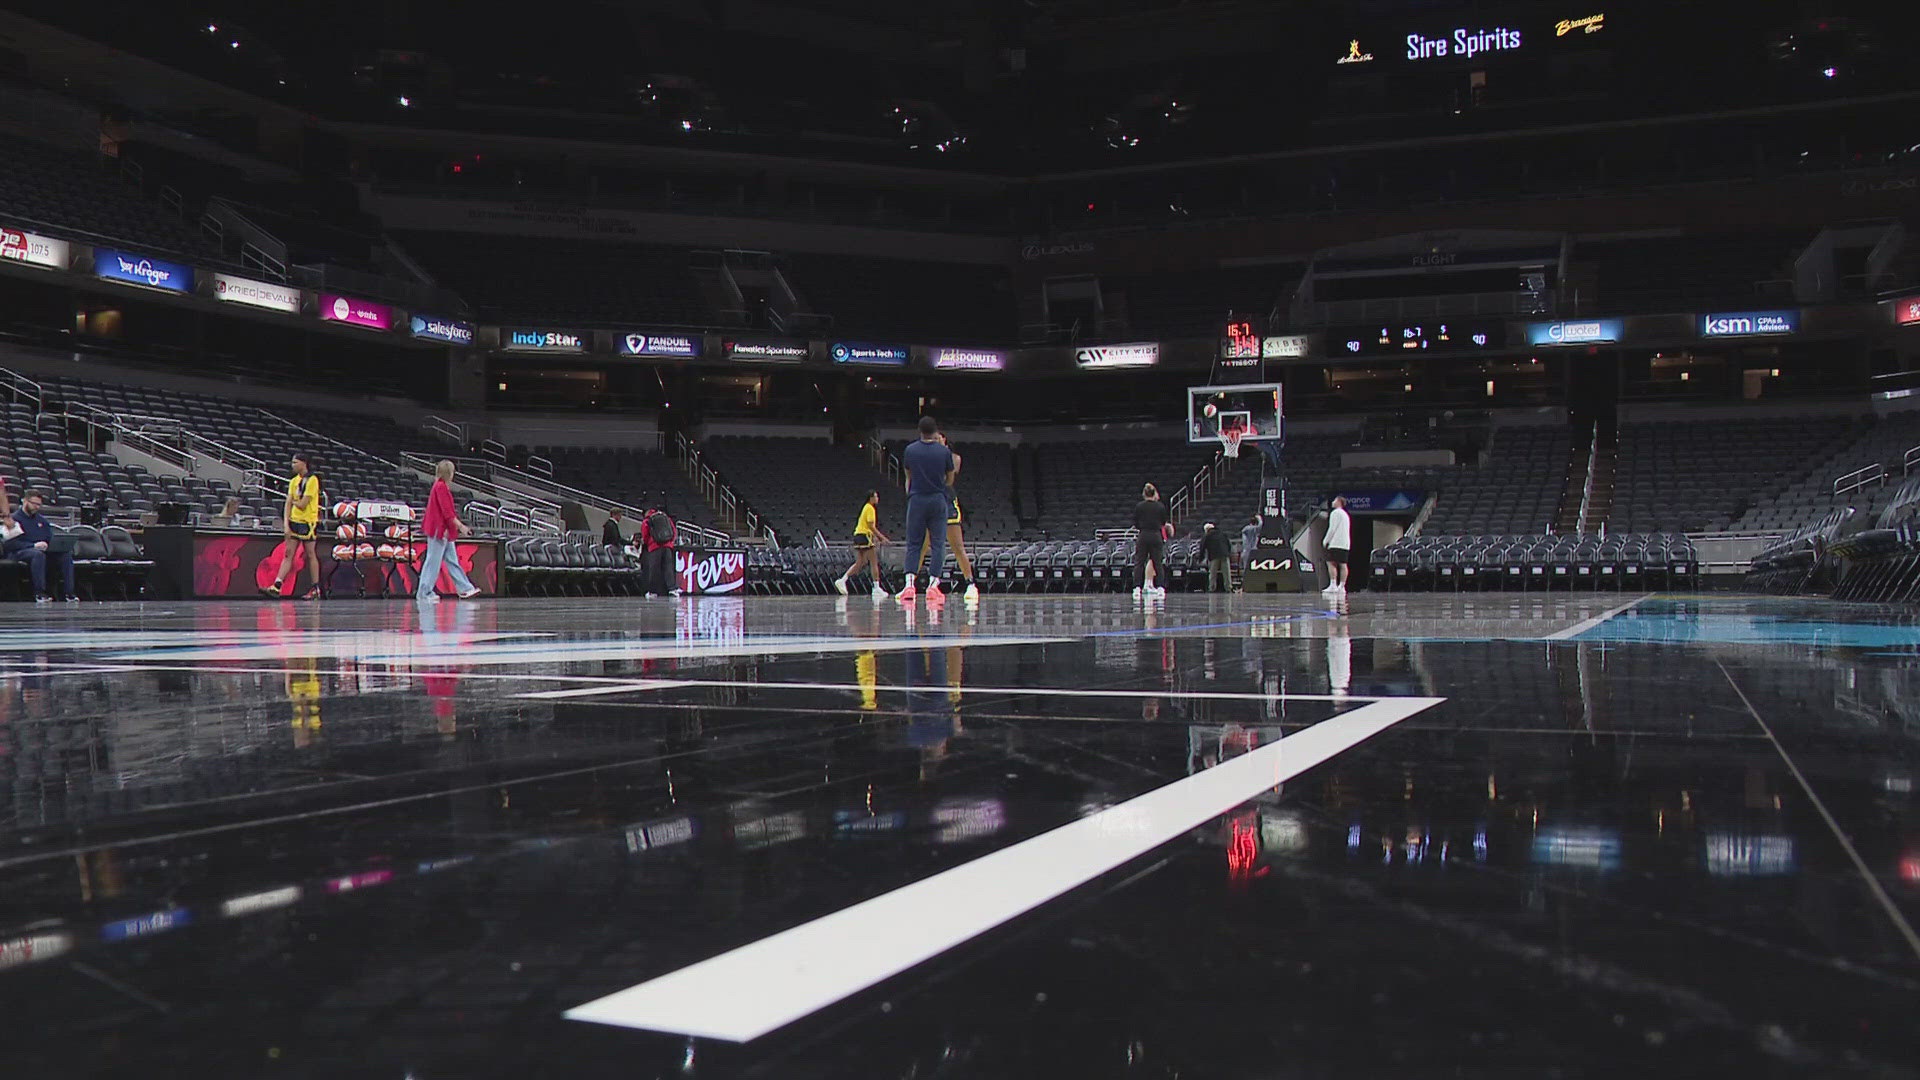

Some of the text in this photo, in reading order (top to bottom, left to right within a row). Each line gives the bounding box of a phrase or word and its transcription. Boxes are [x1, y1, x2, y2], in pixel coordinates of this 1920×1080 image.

[1555, 13, 1604, 36] Branson
[1407, 27, 1521, 60] Sire Spirits
[30, 242, 50, 257] 107.5
[1412, 254, 1456, 266] FLIGHT
[134, 260, 170, 286] Kroger
[228, 285, 255, 297] KRIEG
[1705, 315, 1750, 334] ksm
[1757, 317, 1776, 325] CPAs
[427, 321, 472, 340] salesforce
[648, 336, 692, 346] FANDUEL
[1266, 338, 1307, 349] XIBER
[734, 344, 766, 354] Fanatics
[851, 349, 906, 359] Sports Tech HQ
[959, 352, 998, 363] DONUTS
[380, 505, 400, 513] Wilson
[1260, 537, 1283, 546] Google
